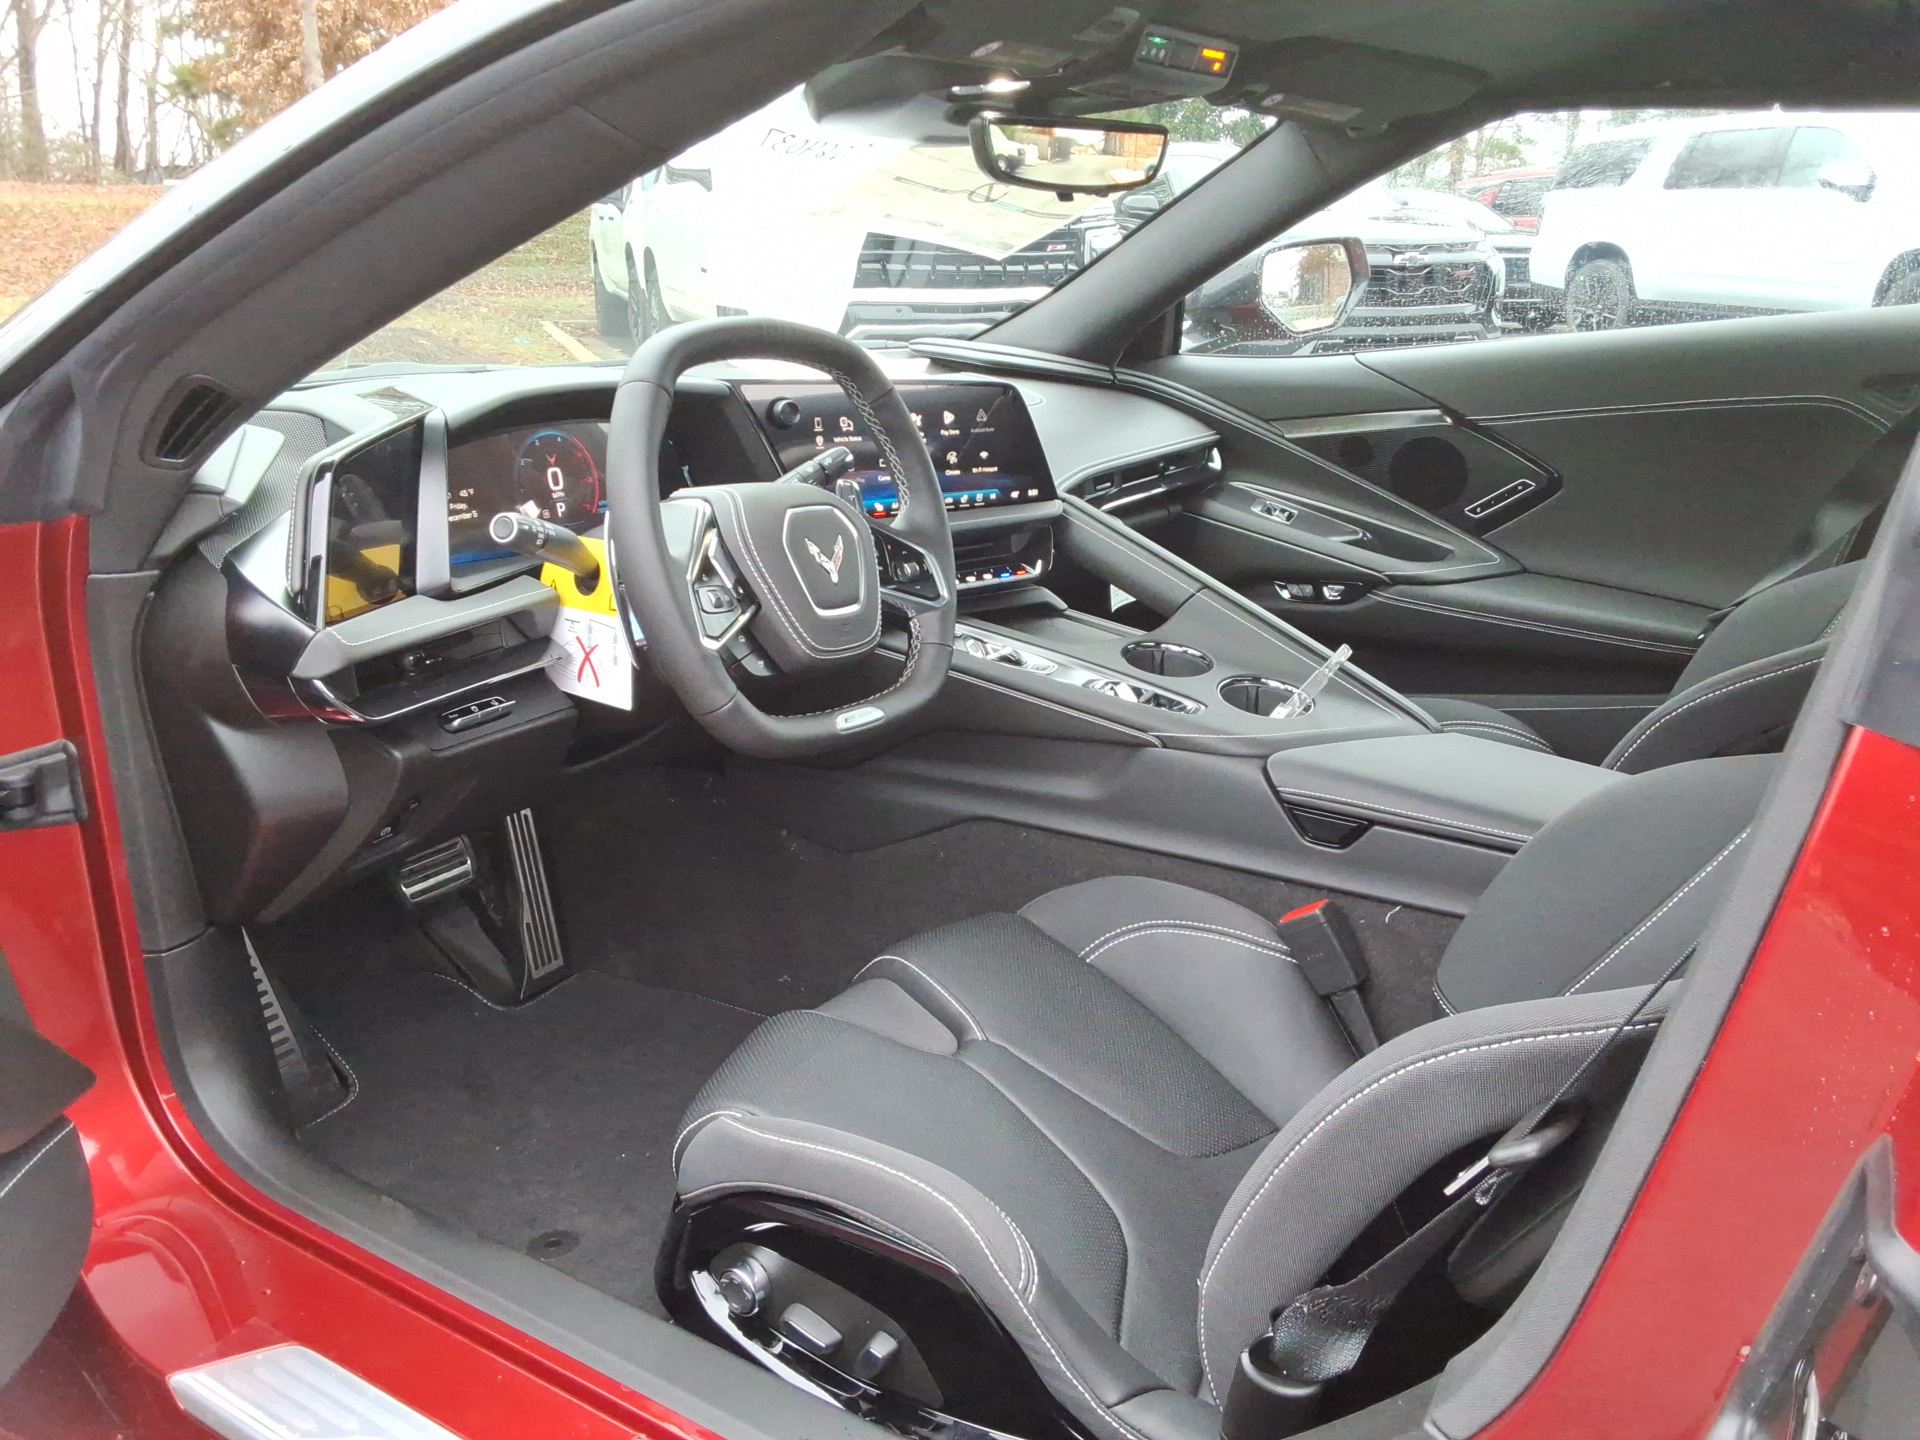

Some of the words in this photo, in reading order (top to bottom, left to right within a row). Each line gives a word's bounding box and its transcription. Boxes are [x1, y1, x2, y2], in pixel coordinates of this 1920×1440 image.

[546, 466, 564, 491] 0
[551, 491, 566, 499] MPH
[449, 502, 469, 511] Friday,
[556, 502, 566, 518] P
[448, 513, 473, 522] ecember
[471, 510, 478, 518] 5
